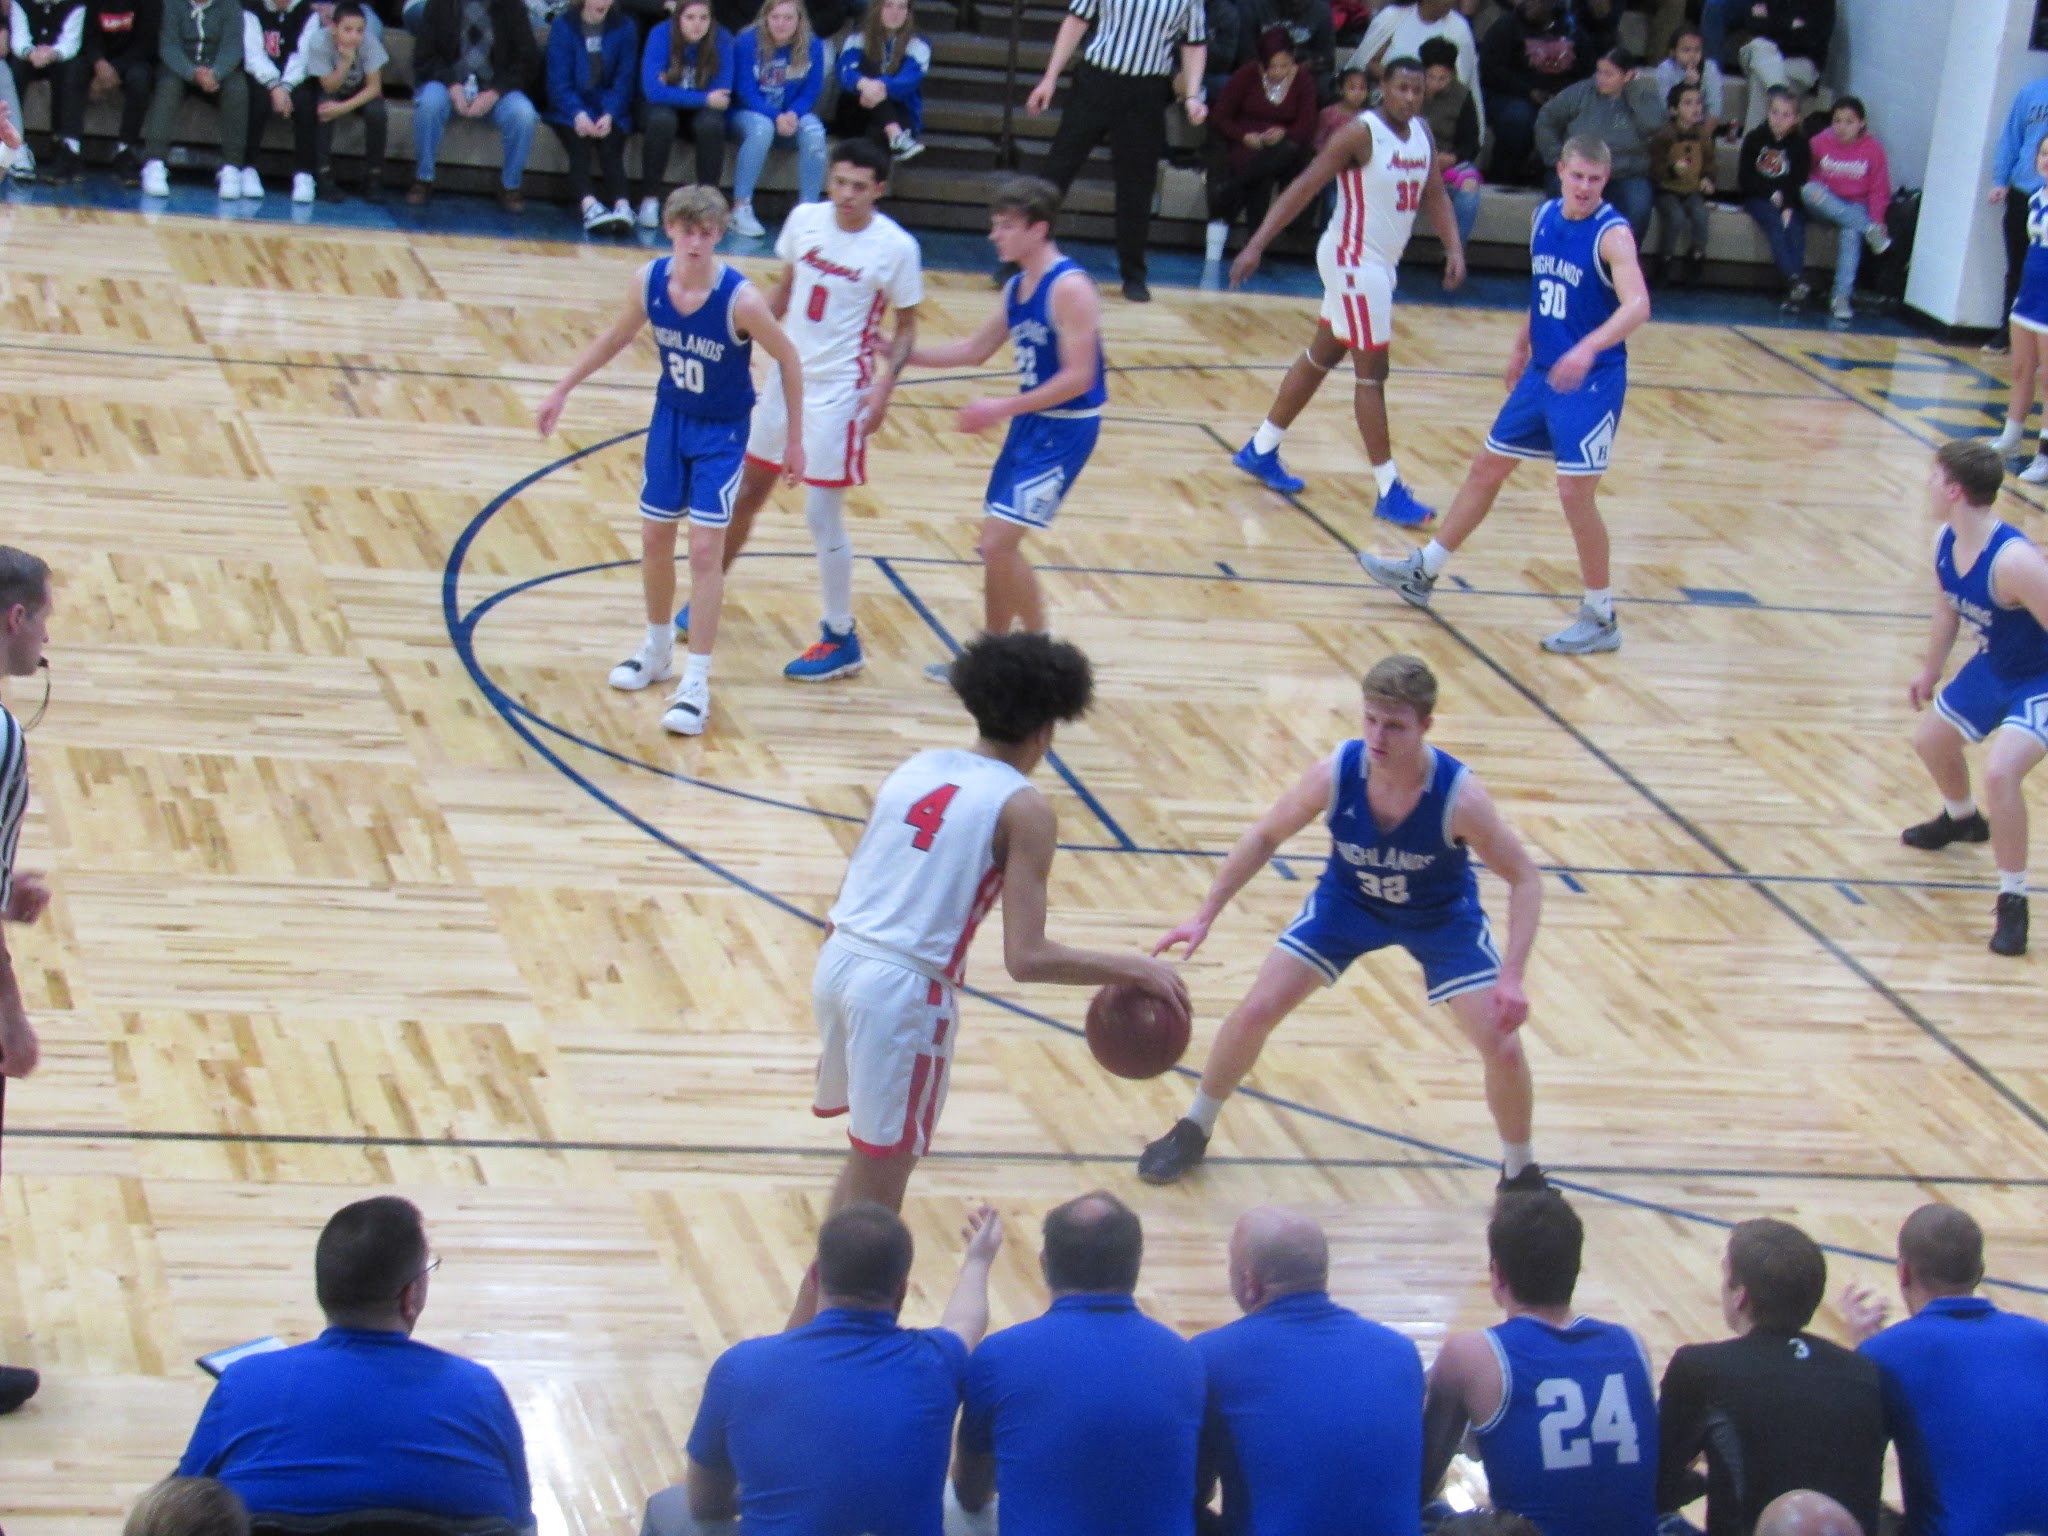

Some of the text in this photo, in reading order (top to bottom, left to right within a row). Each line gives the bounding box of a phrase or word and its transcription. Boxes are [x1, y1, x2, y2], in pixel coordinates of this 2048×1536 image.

[806, 285, 829, 322] 0
[1539, 279, 1567, 320] 30
[668, 352, 705, 394] 20
[903, 782, 961, 853] 4
[1536, 1373, 1640, 1471] 24
